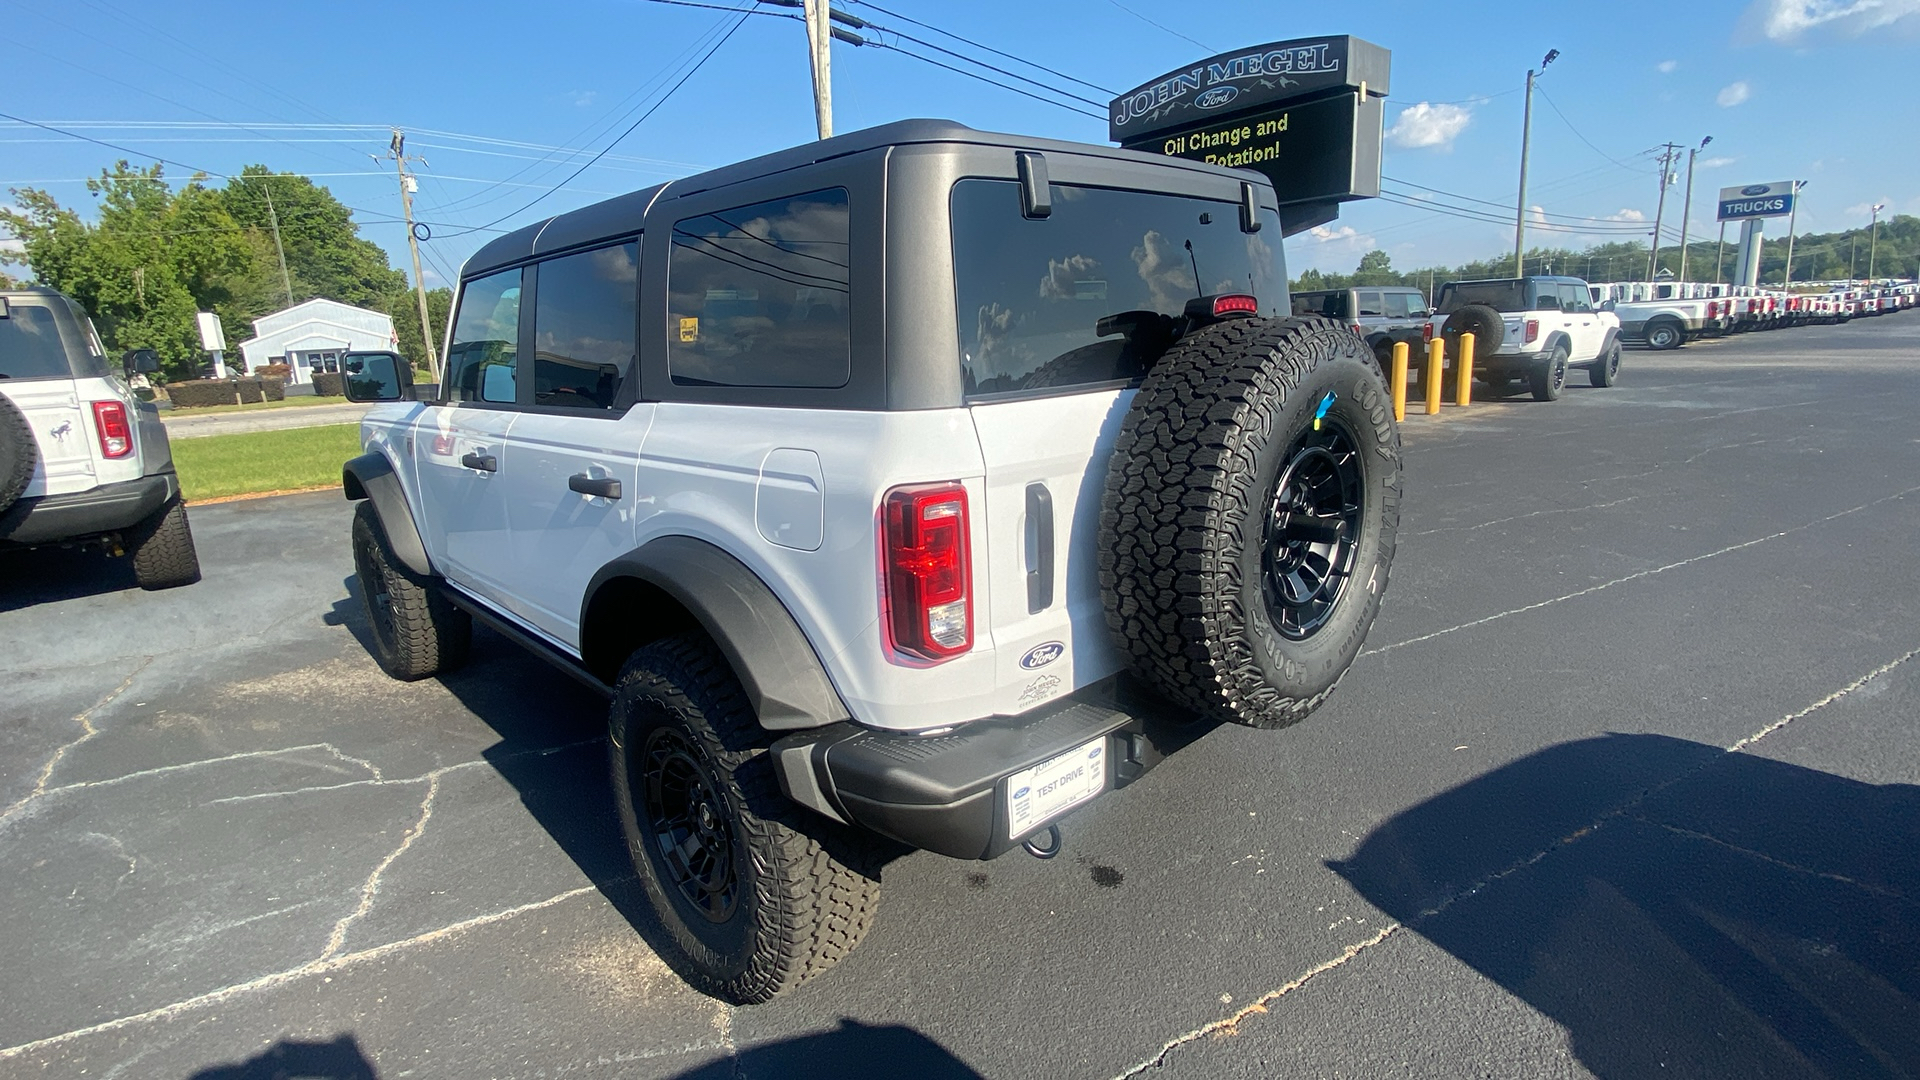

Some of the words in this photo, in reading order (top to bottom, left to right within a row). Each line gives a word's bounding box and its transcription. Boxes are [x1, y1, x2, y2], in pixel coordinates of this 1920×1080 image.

[1116, 67, 1203, 126] JOHN
[1207, 44, 1339, 86] MEGEL
[1199, 89, 1232, 108] Ford
[1164, 137, 1185, 156] Oil
[1189, 126, 1251, 151] Change
[1256, 113, 1289, 137] and
[1726, 199, 1784, 214] TRUCKS
[1027, 644, 1060, 668] Ford
[1037, 779, 1059, 798] TEST
[1060, 765, 1084, 786] DRIVE
